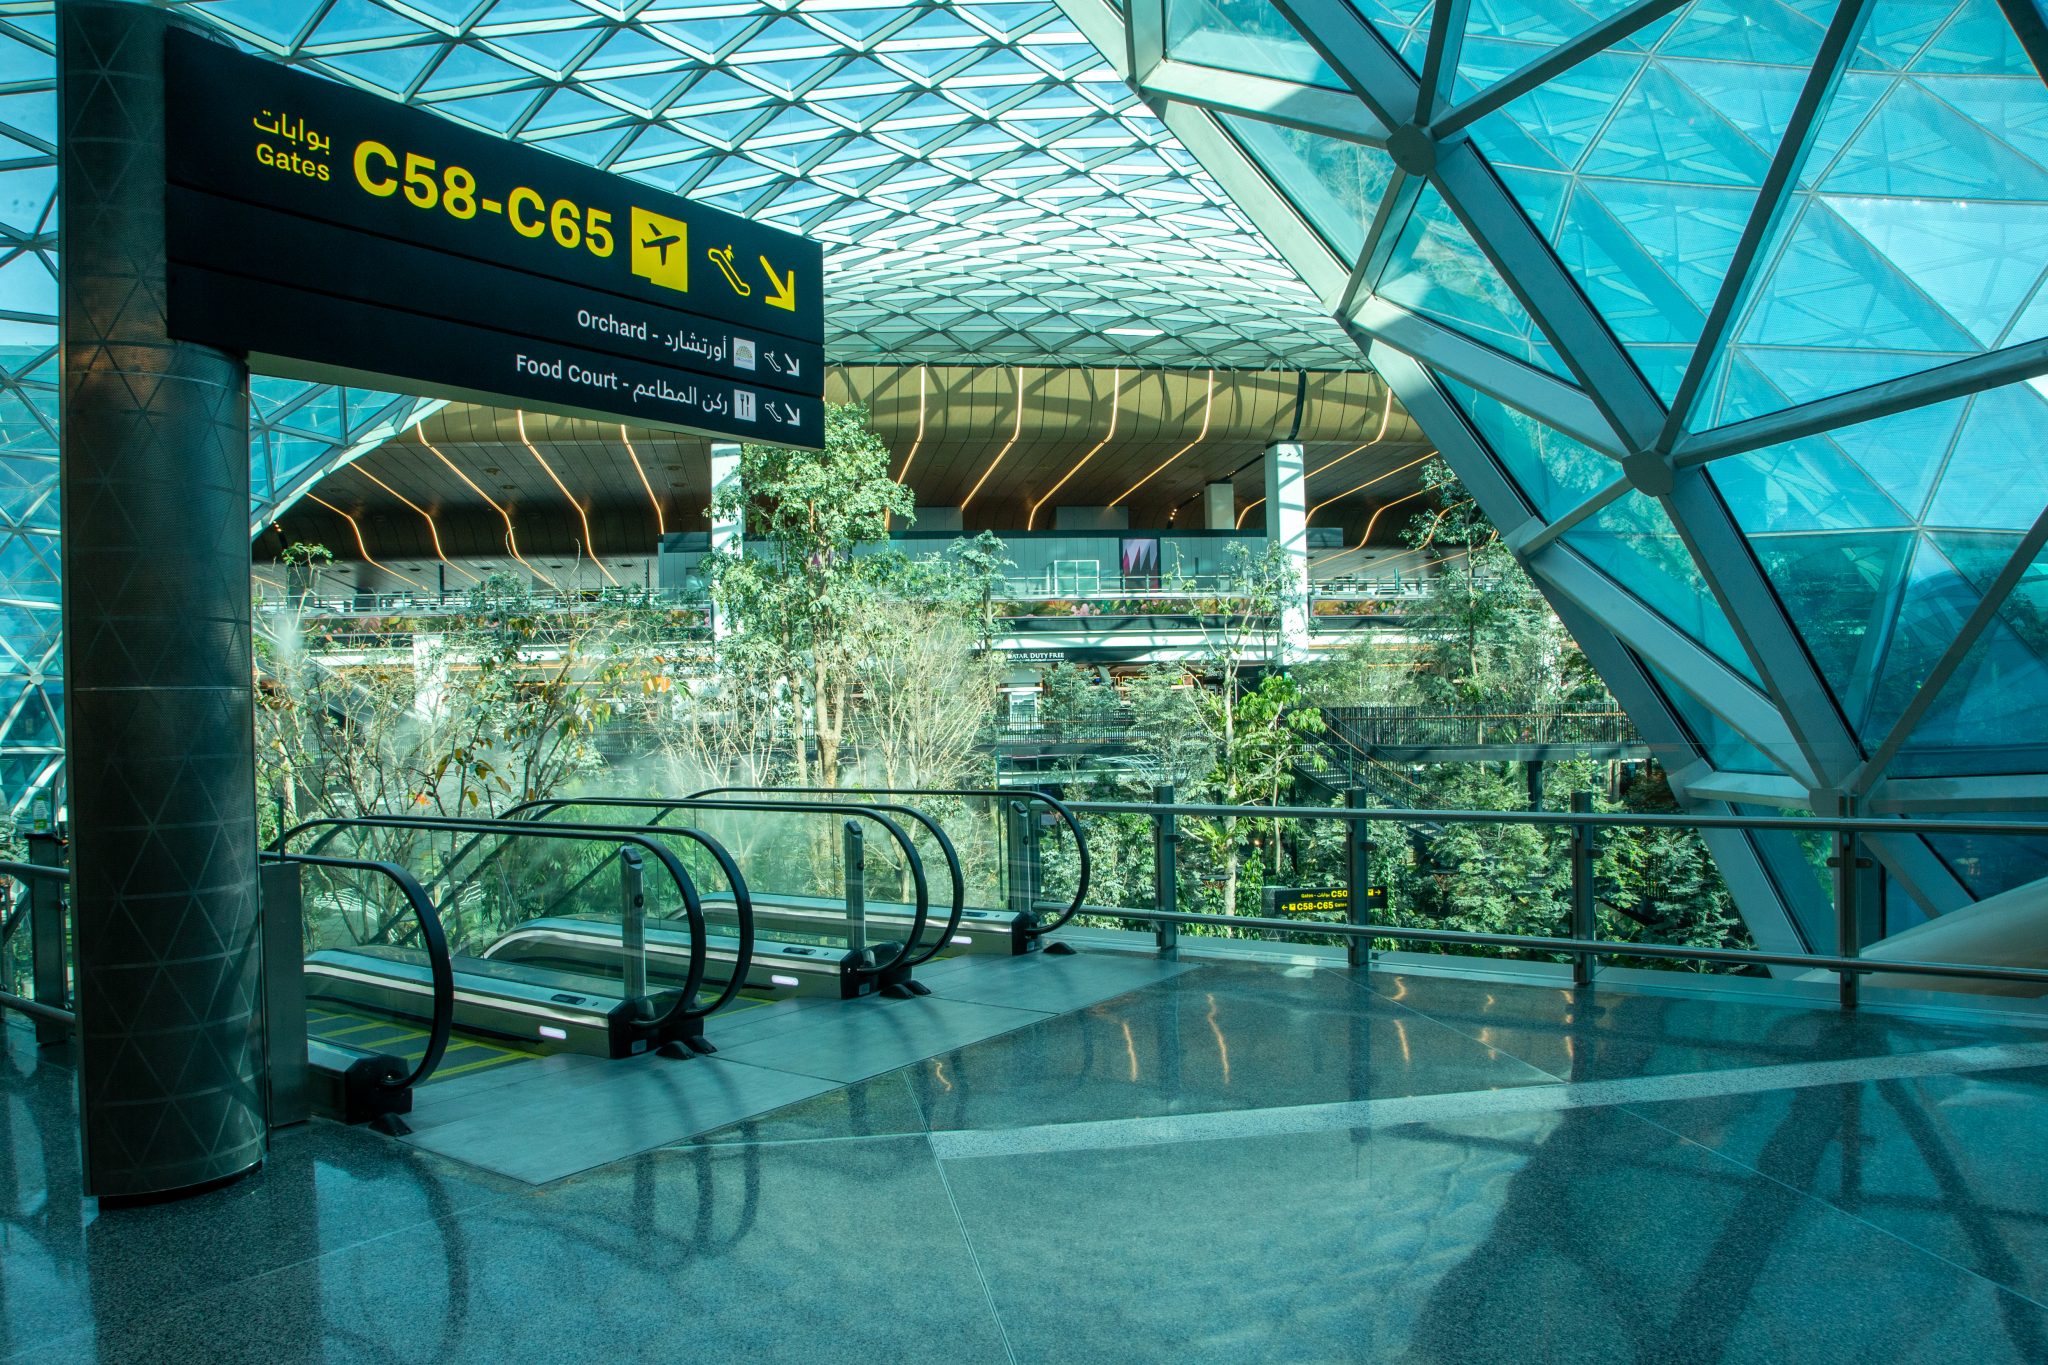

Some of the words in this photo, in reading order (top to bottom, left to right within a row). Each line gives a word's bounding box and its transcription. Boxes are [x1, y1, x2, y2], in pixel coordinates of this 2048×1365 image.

[253, 109, 330, 155] بوابات
[256, 143, 330, 181] Gates
[353, 140, 614, 258] C58-C65
[577, 309, 647, 341] Orchard
[664, 330, 727, 362] أورتشارد
[516, 353, 562, 380] Food
[567, 364, 618, 390] Court
[632, 379, 697, 403] المطاعم
[702, 393, 728, 415] ركن
[1297, 902, 1334, 911] C58-C65
